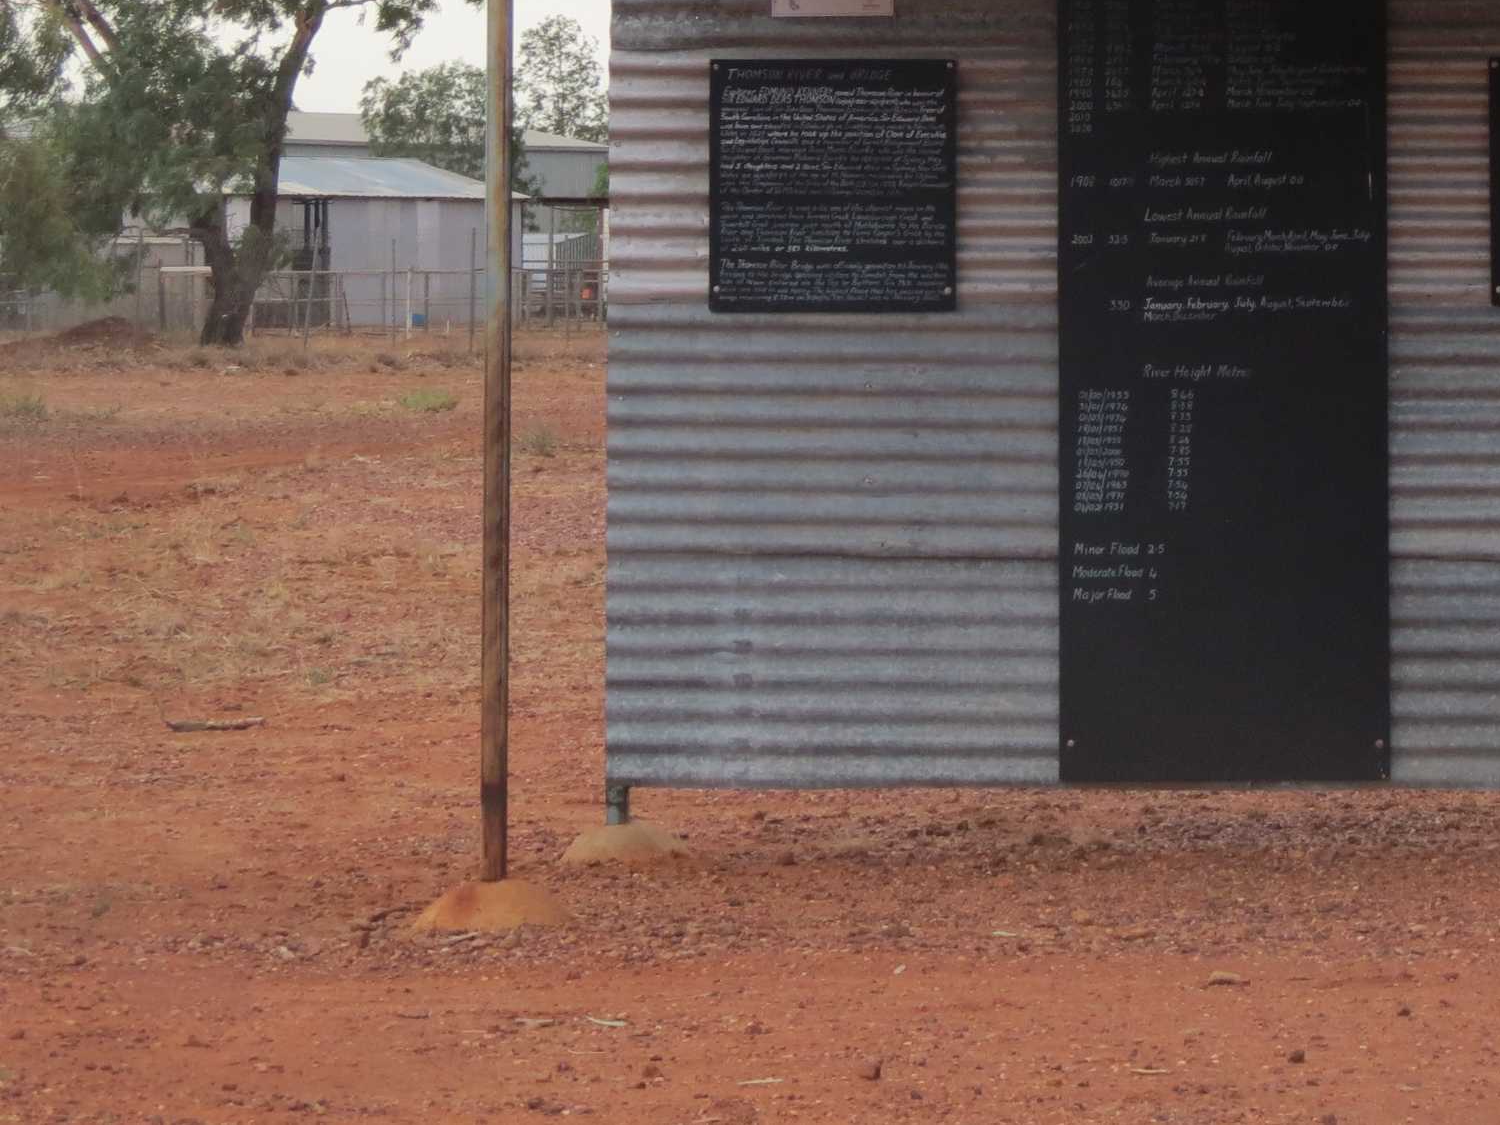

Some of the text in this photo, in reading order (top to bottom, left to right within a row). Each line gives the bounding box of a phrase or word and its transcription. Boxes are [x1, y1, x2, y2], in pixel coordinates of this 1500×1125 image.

[1192, 151, 1228, 164] Annual
[1144, 207, 1183, 222] Lowest
[1186, 206, 1223, 221] Annual
[1142, 363, 1170, 378] River
[1173, 363, 1212, 381] Height
[1073, 542, 1106, 555] Minor
[1110, 541, 1140, 556] Flood
[1118, 563, 1145, 578] Flood
[1073, 587, 1158, 604] Major Flood 5
